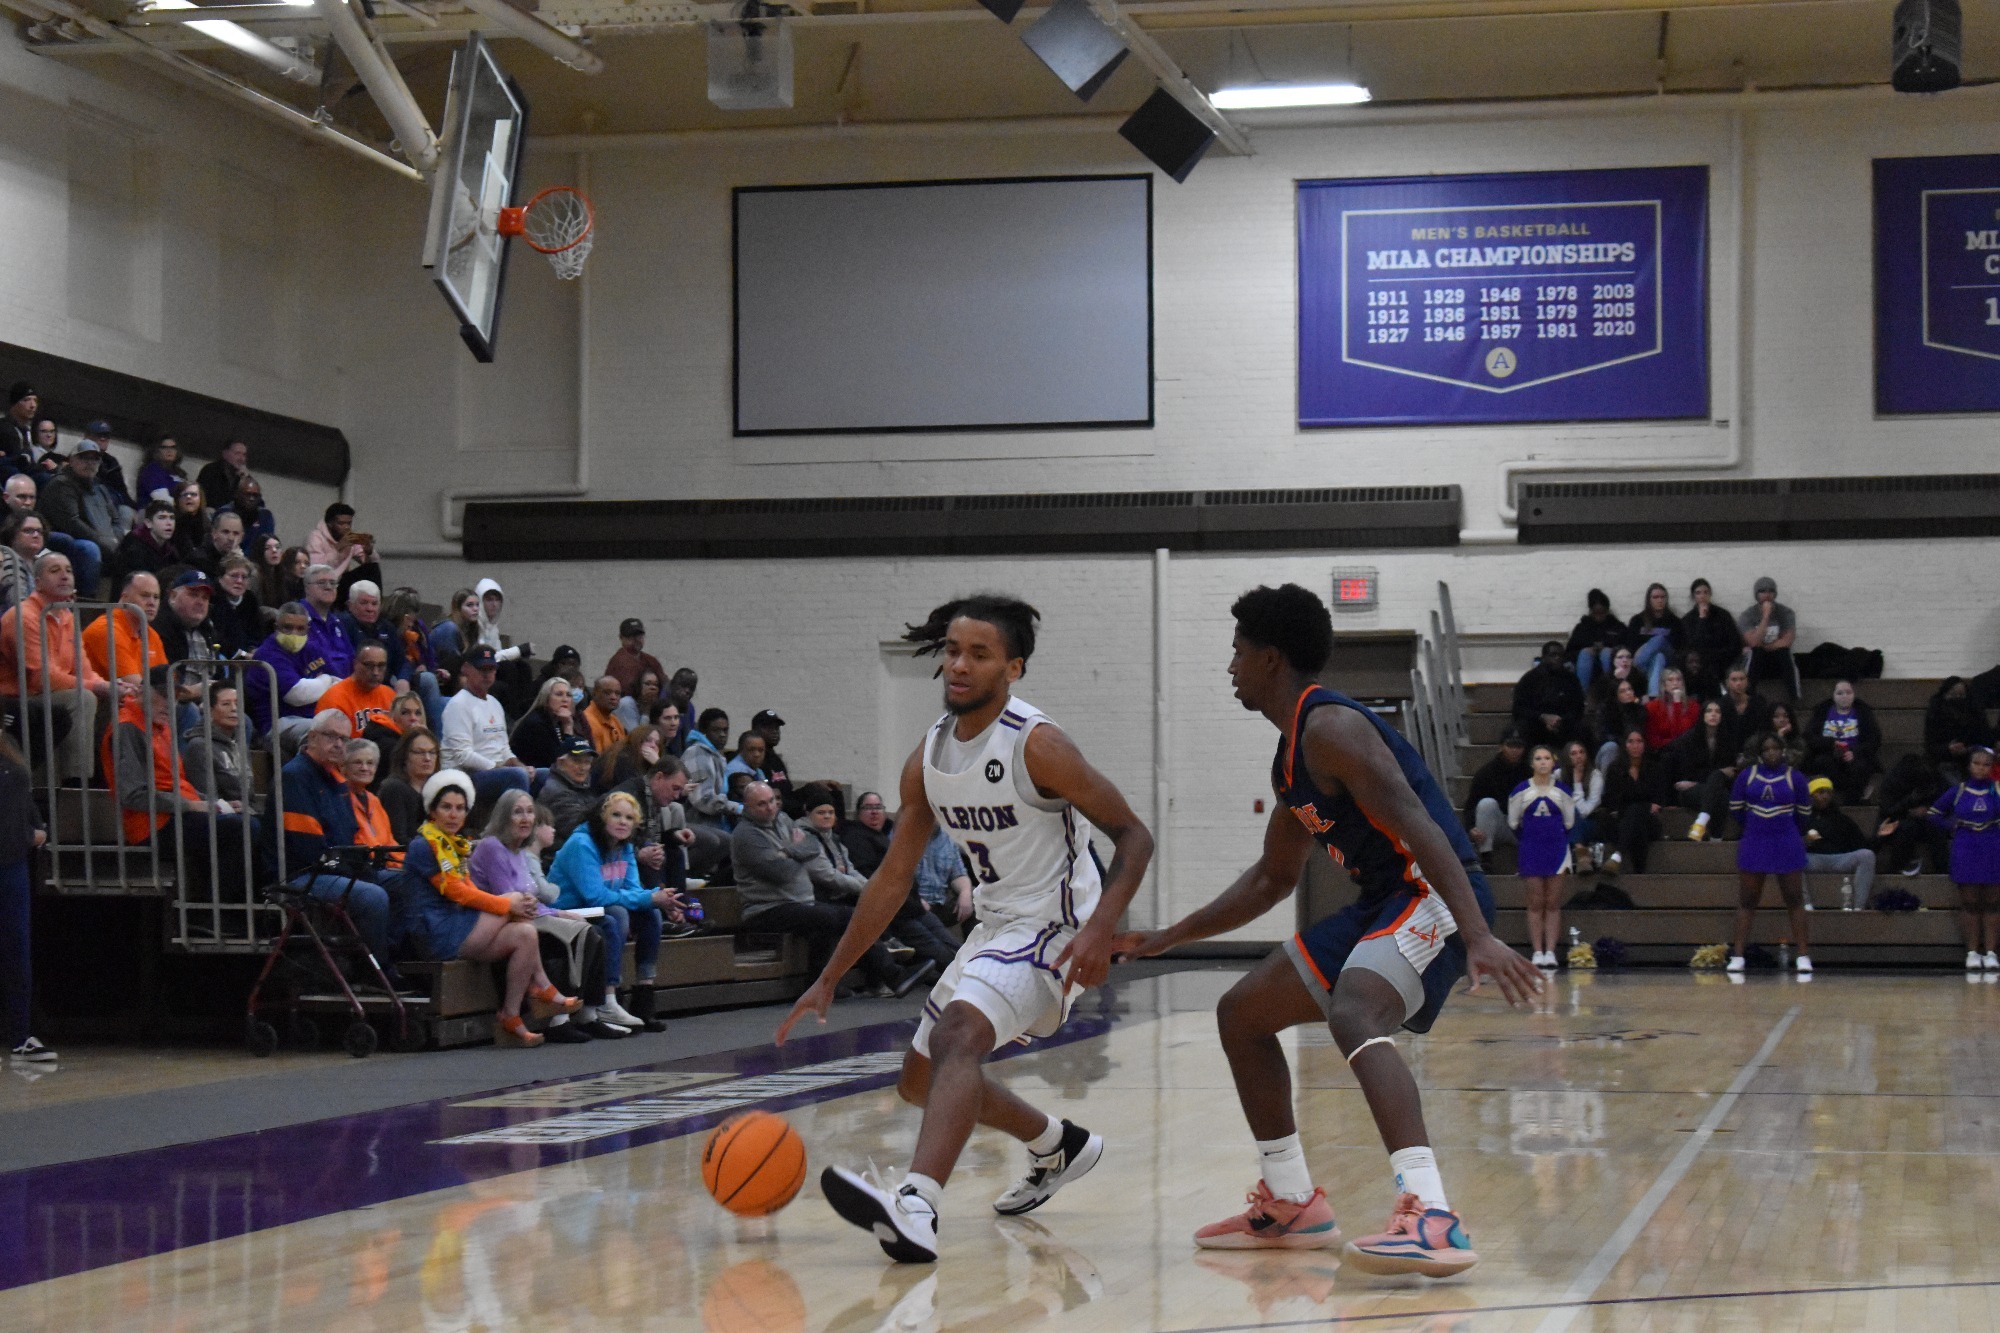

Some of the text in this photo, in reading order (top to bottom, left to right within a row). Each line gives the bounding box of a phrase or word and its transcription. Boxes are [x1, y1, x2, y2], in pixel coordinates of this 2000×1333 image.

[1410, 222, 1591, 242] MEN'S BASKETBALL
[1966, 230, 2000, 251] MI
[1366, 242, 1636, 271] MIAA CHAMPIONSHIPS
[1367, 283, 1635, 307] 1911 1929 1948 1978 2003
[1367, 308, 1410, 326] 1912
[1423, 307, 1466, 324] 1936
[1536, 303, 1578, 320] 1979
[1592, 302, 1636, 319] 2005
[1367, 320, 1636, 344] 1927 1946 1957 1981 2020
[1491, 352, 1511, 370] A
[1762, 784, 1775, 801] A
[1532, 799, 1552, 817] A
